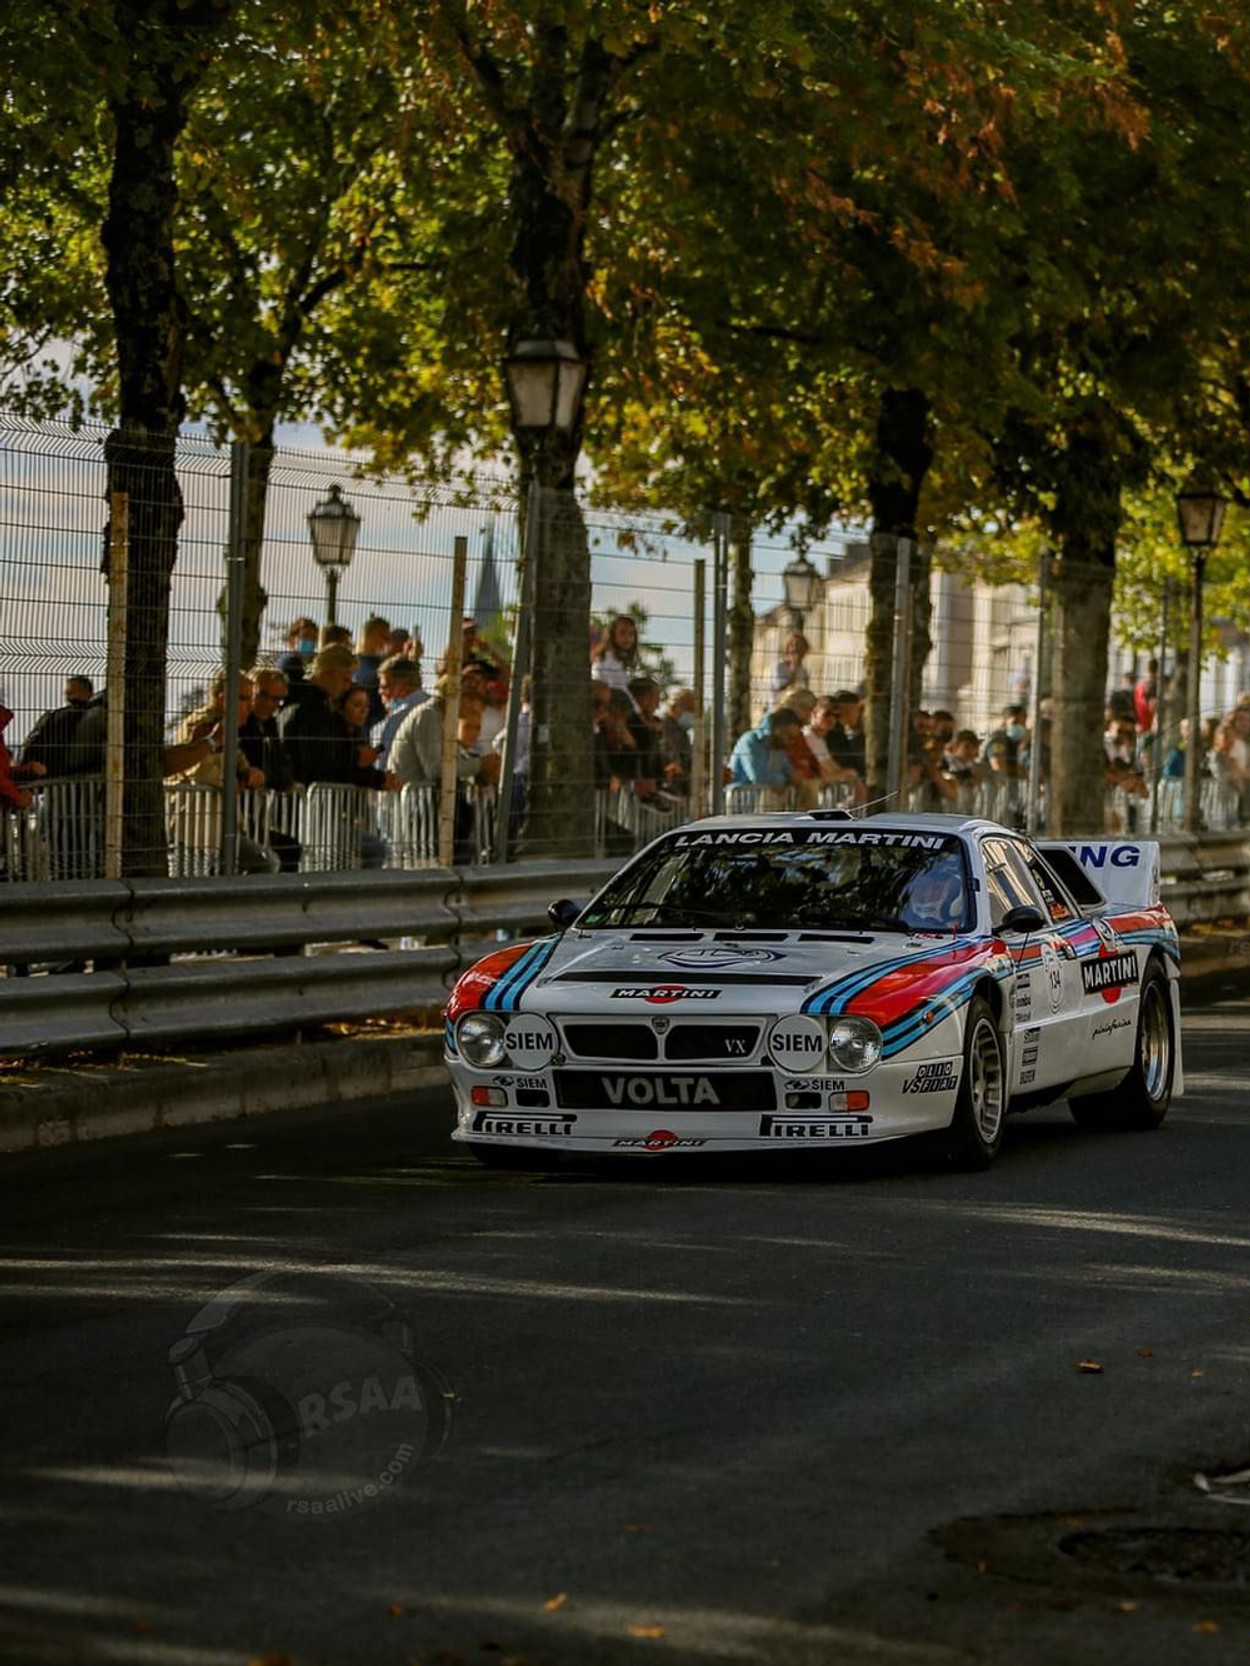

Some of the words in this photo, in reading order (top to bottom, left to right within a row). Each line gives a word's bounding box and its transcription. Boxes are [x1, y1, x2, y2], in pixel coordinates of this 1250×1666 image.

[674, 832, 794, 848] LANCIA
[806, 832, 946, 849] MARTINI
[1084, 956, 1138, 989] MARTINI
[617, 988, 715, 999] MARTINI
[505, 1032, 554, 1050] SIEM
[724, 1040, 747, 1054] VX
[772, 1033, 823, 1053] SIEM
[916, 1061, 954, 1079] OLIO
[516, 1077, 549, 1090] SIEM
[601, 1077, 721, 1105] VOLTA
[810, 1079, 846, 1091] SIEM
[472, 1110, 578, 1136] PIRELLI
[759, 1114, 874, 1138] PIRELLI
[617, 1139, 704, 1148] MARTINI
